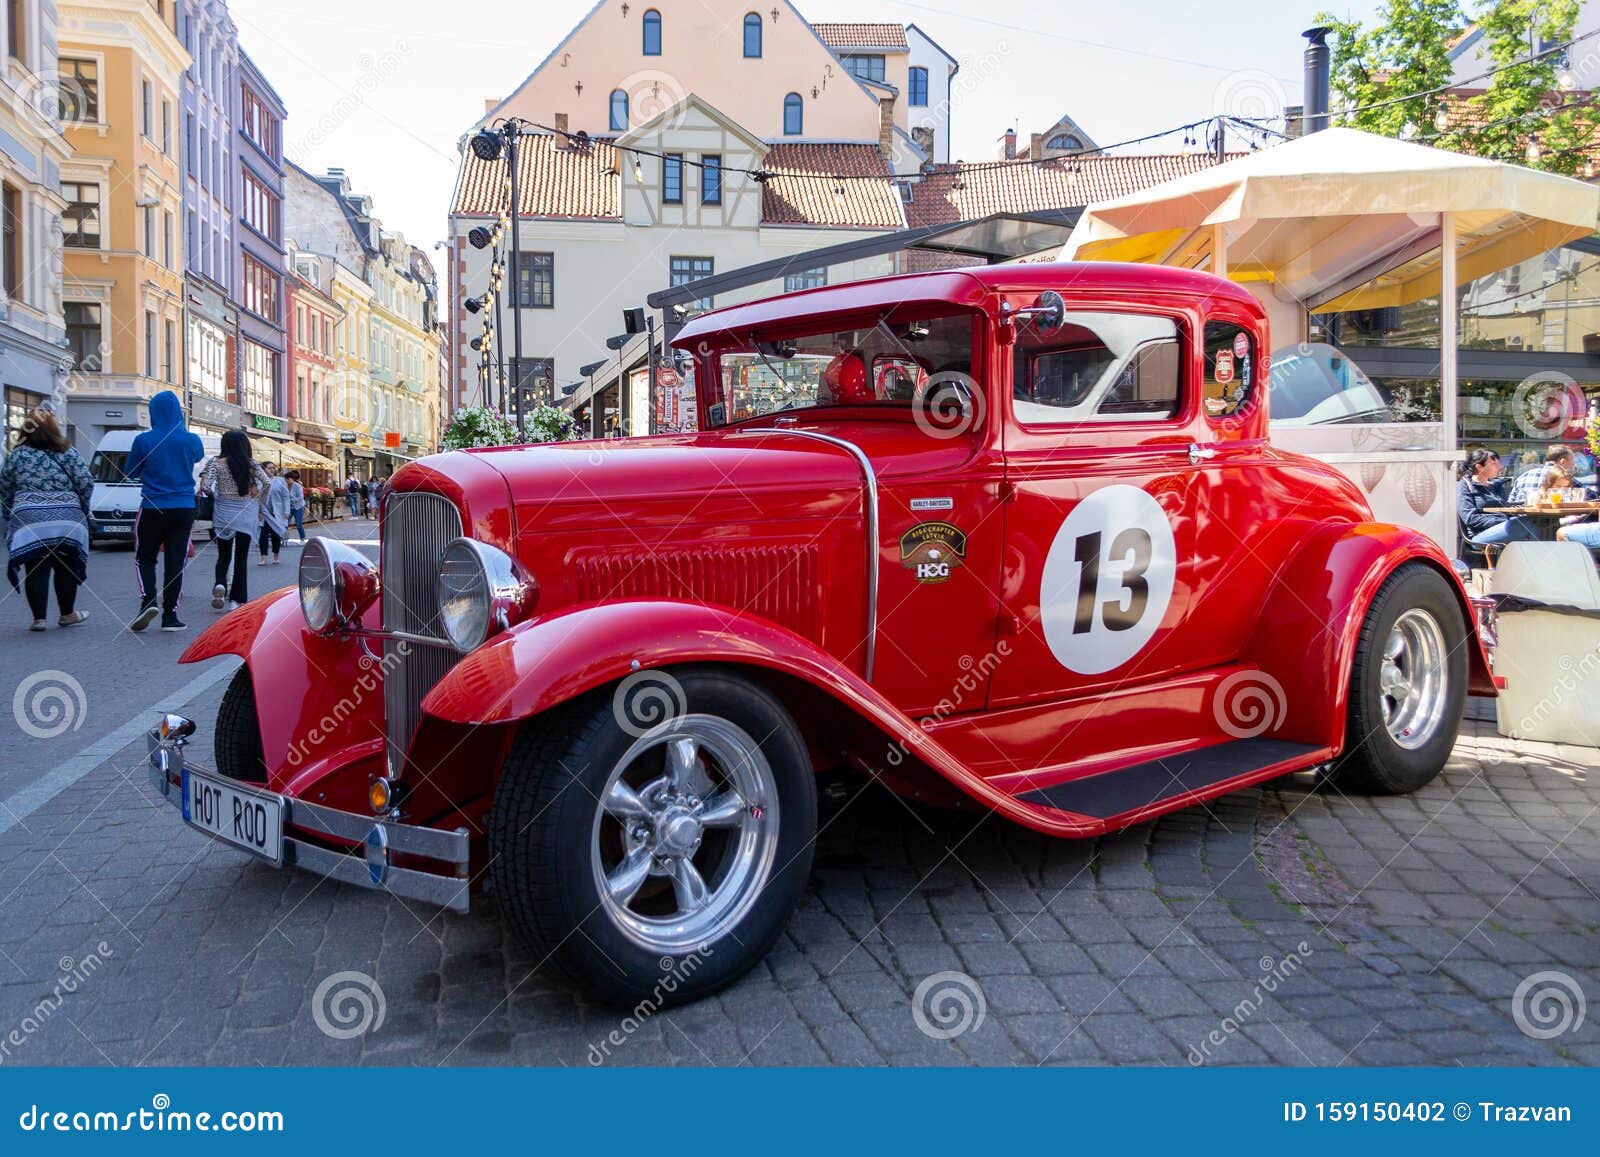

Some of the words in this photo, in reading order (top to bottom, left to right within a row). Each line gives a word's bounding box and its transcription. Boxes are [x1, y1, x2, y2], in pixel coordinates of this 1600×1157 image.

[928, 525, 955, 536] CHAPTER
[917, 563, 949, 578] HOG
[1072, 528, 1152, 634] 13
[194, 781, 222, 830] HOT
[233, 795, 266, 848] ROD
